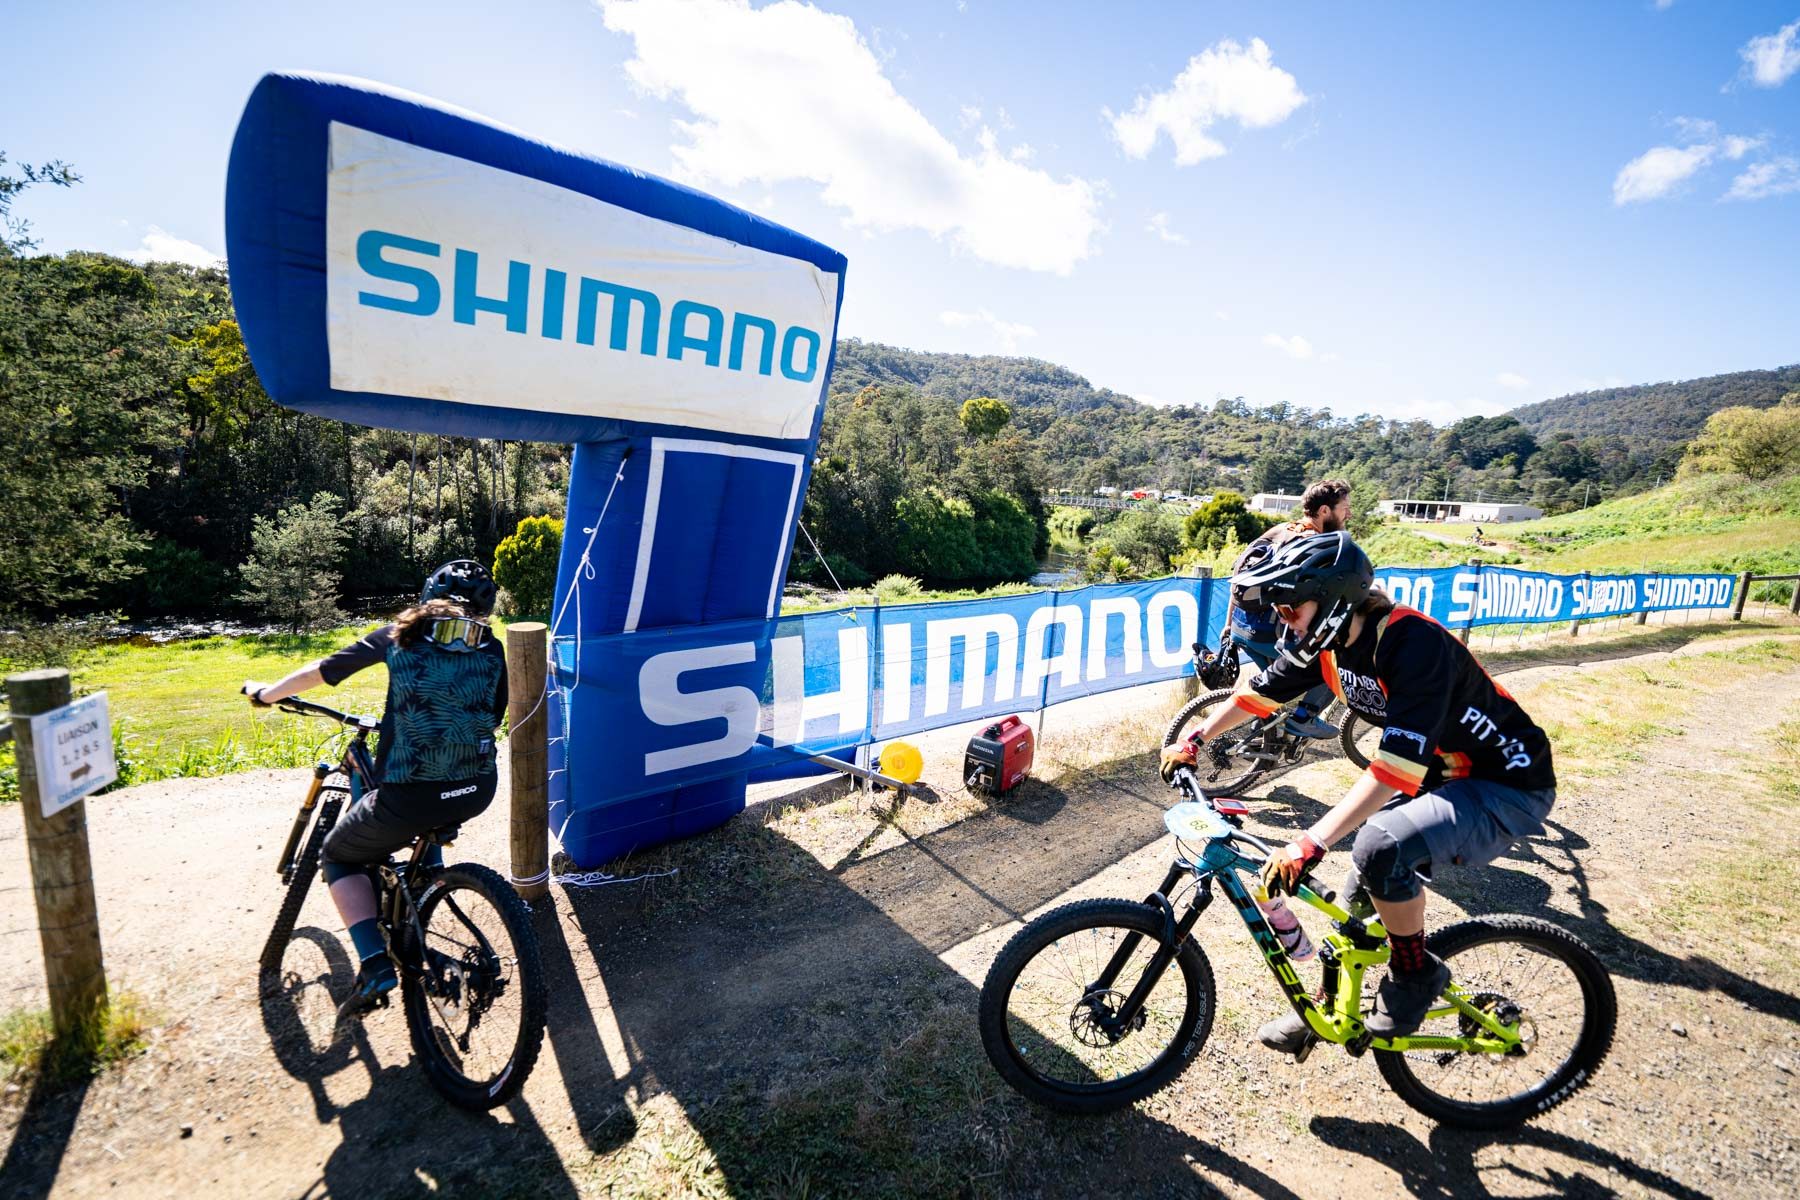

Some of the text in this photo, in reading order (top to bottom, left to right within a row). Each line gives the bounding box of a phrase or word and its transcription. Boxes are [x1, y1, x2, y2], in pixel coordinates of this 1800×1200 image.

[356, 230, 821, 384] SHIMANO
[1448, 573, 1563, 622] SHIMANO
[1643, 578, 1731, 608] SHIMANO
[638, 590, 1199, 775] SHIMANO
[58, 720, 98, 745] LIAISON
[1460, 706, 1497, 741] PIT
[972, 744, 994, 755] HONDA
[1199, 991, 1207, 1016] ISSUE
[1537, 1069, 1586, 1111] MAXXIS
